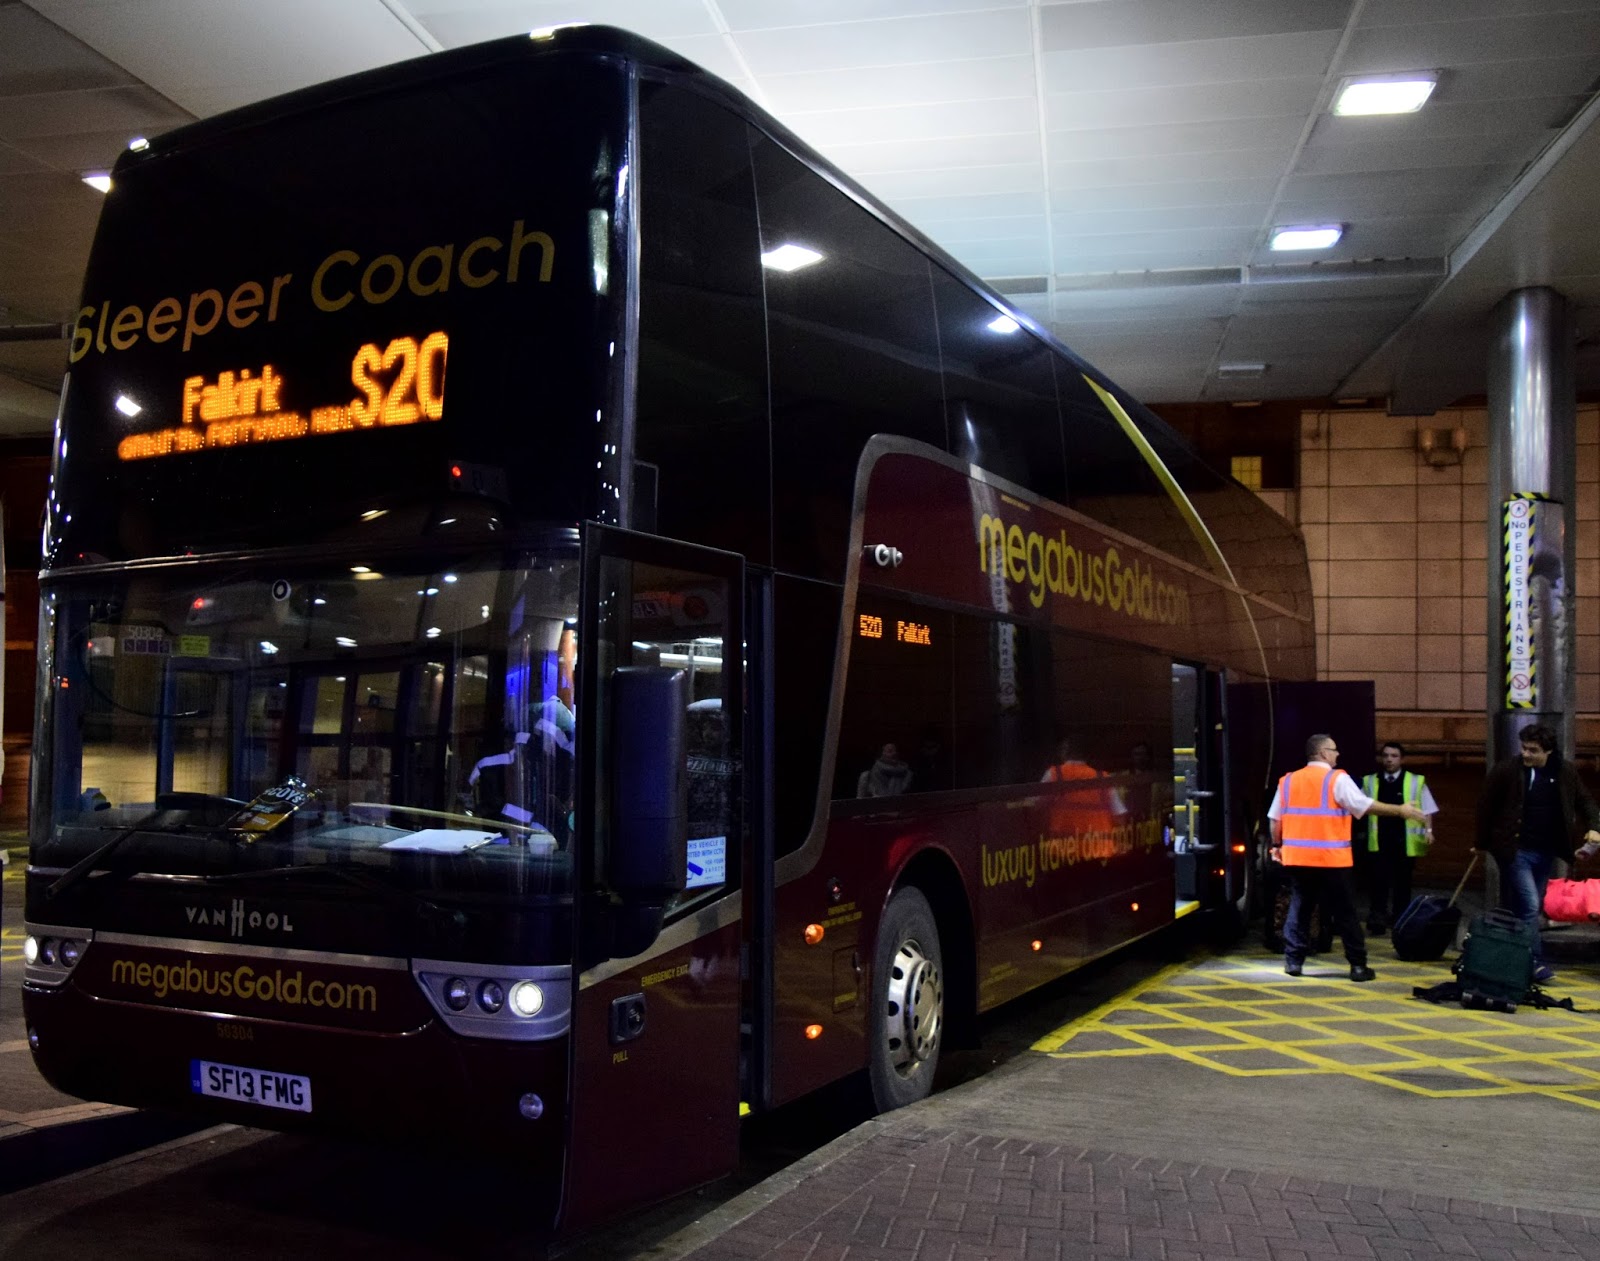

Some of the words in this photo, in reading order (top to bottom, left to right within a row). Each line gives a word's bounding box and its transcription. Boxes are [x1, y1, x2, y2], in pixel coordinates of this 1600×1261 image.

[69, 273, 293, 364] Sleeper
[311, 219, 556, 312] Coach
[183, 364, 283, 423] Falkirk
[1510, 521, 1527, 530] No
[980, 512, 1190, 627] megabusGold.com
[1514, 531, 1525, 656] PEDESTRIANS
[897, 620, 932, 646] Falkirk
[699, 840, 718, 848] VEHICLE
[981, 843, 1036, 888] luxury
[1039, 826, 1081, 872] travel
[111, 958, 377, 1012] megabusGold.com
[641, 967, 676, 988] EMERGENCY
[676, 964, 688, 977] EXIT
[613, 1050, 628, 1065] PULL
[208, 1065, 255, 1098] SF13
[260, 1074, 304, 1106] FMG
